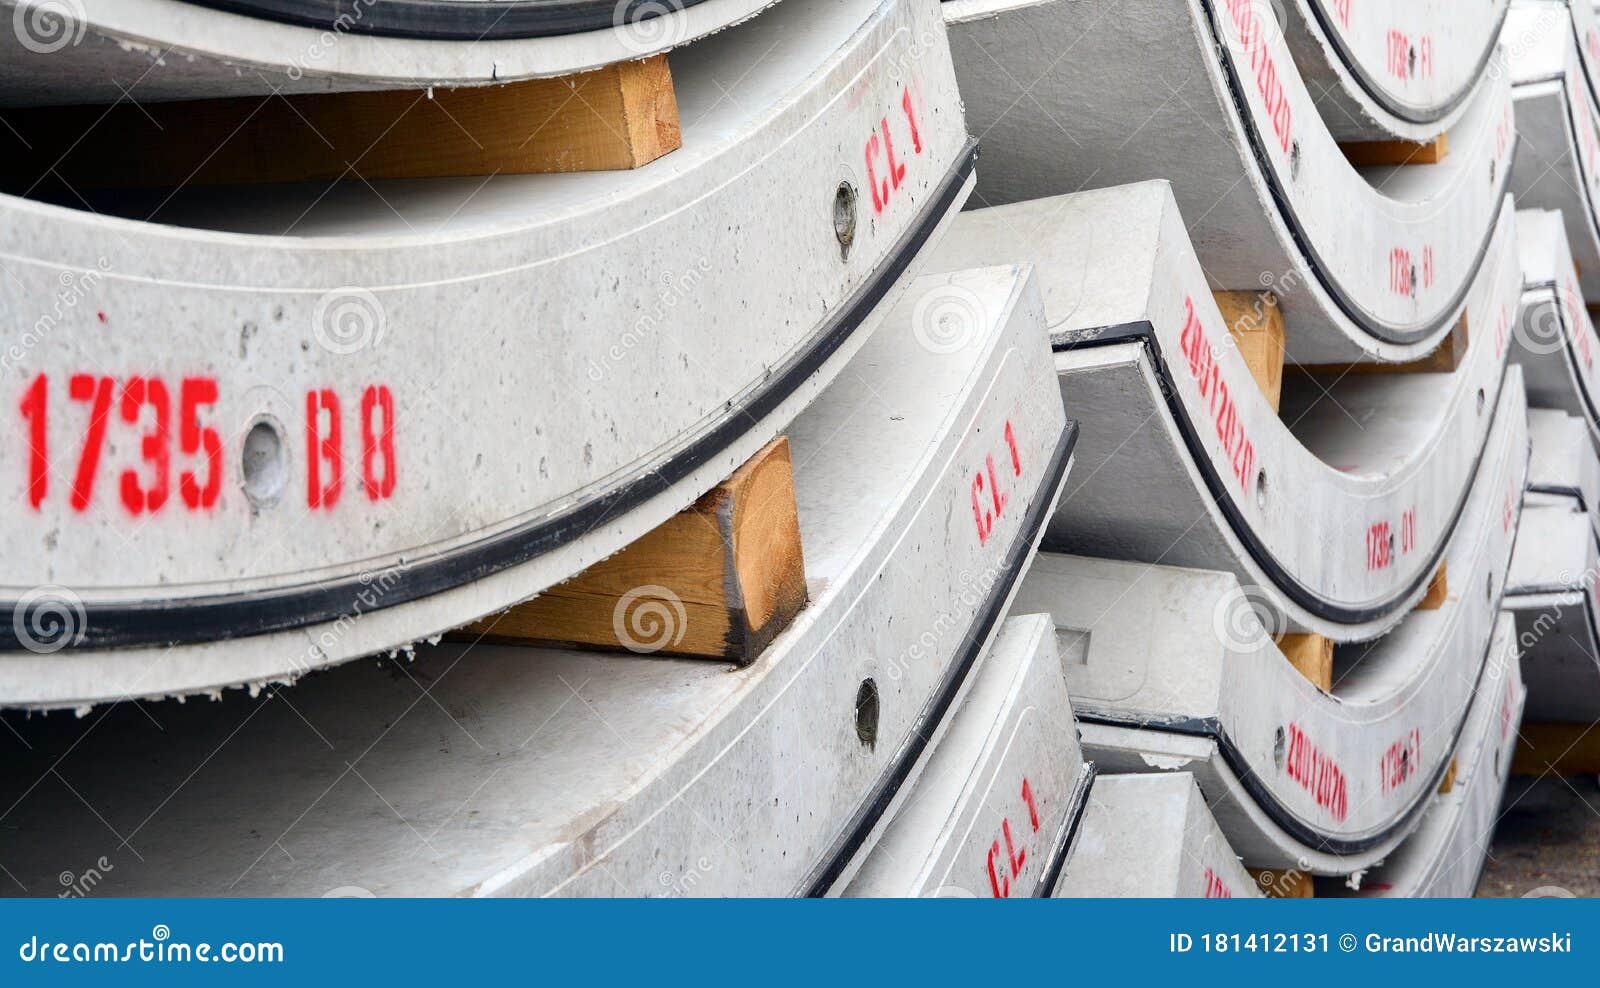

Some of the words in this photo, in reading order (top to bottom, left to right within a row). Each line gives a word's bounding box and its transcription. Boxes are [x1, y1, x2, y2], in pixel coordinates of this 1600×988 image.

[865, 116, 905, 214] CL
[902, 86, 921, 154] 1
[20, 373, 223, 515] 1735
[971, 452, 1008, 542] CL
[1004, 420, 1021, 477] 1
[987, 817, 1026, 898] CL
[1021, 777, 1040, 833] 1
